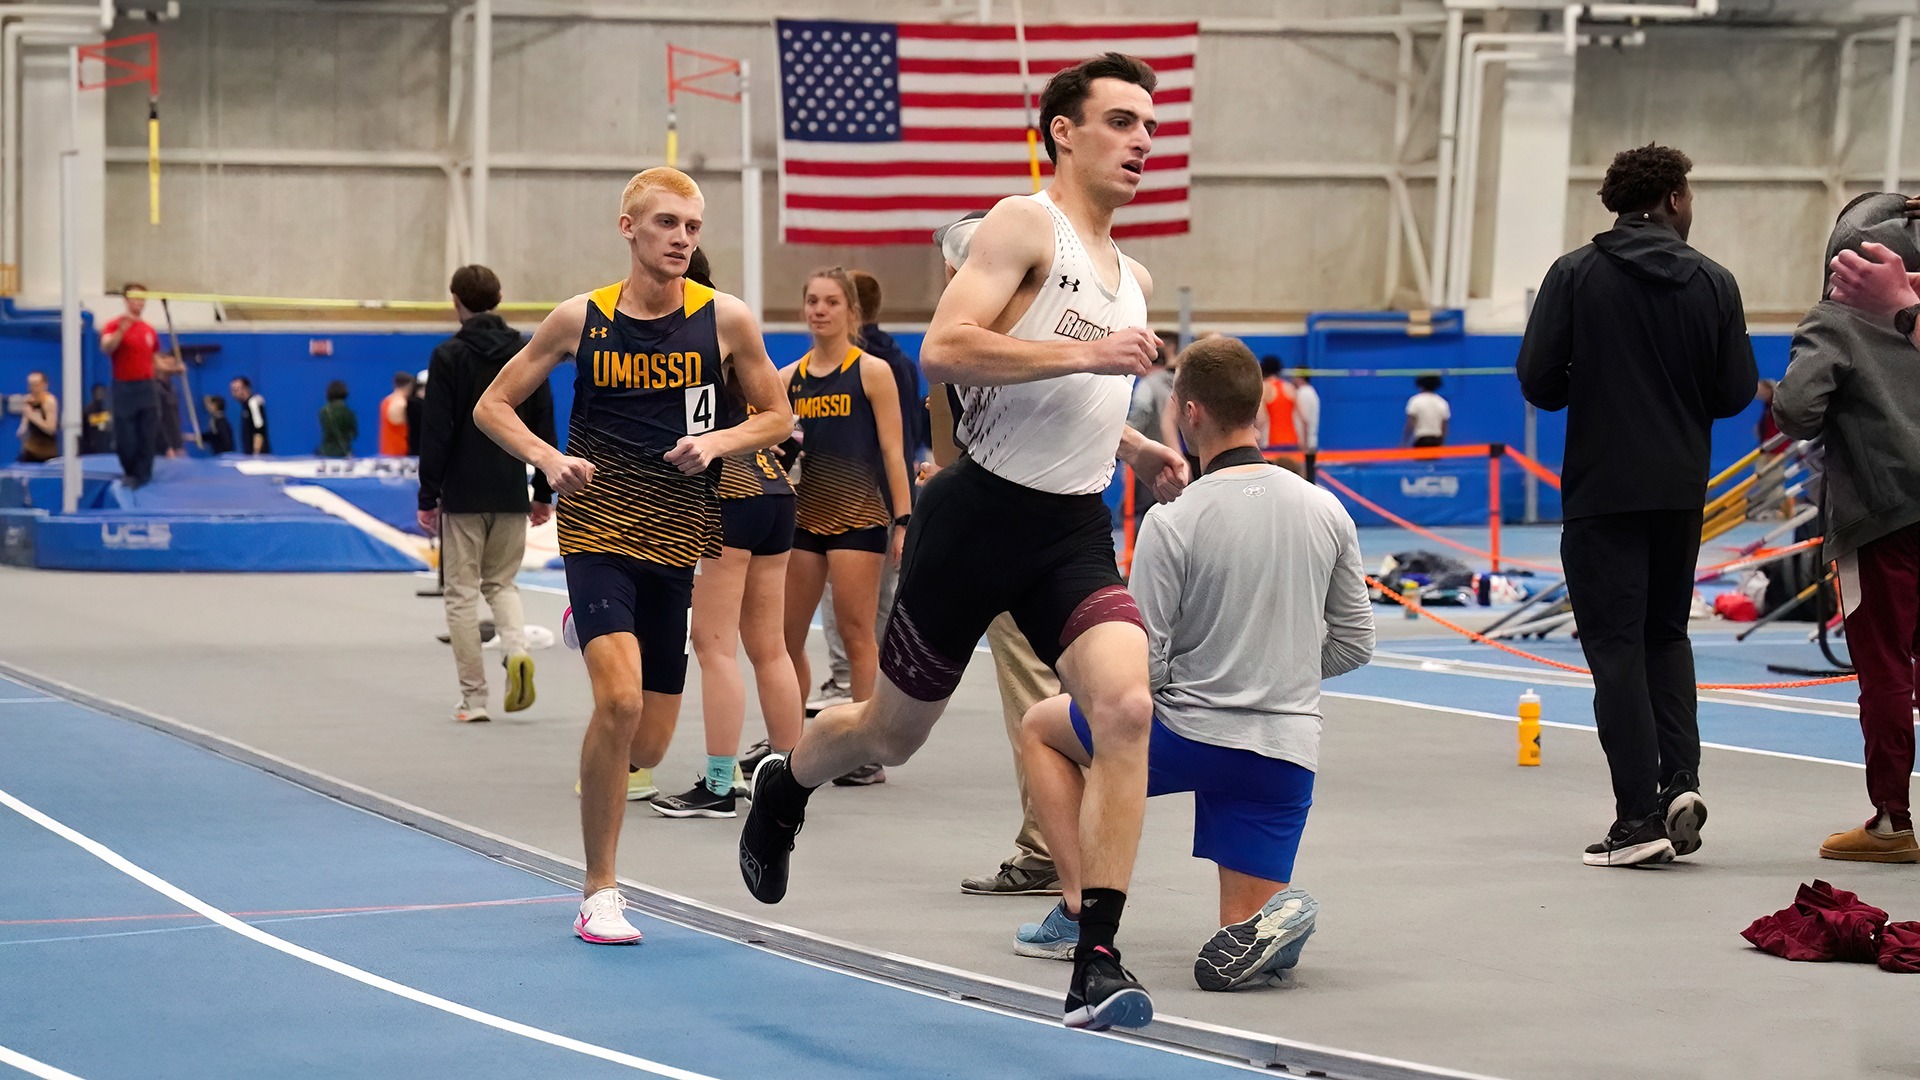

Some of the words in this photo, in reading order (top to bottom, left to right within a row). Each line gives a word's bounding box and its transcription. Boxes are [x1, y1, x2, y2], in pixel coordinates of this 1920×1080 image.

[593, 350, 702, 389] UMASSD
[692, 388, 712, 429] 4
[794, 393, 851, 419] UMASSD
[1400, 475, 1459, 496] UCS
[101, 522, 172, 548] UCS
